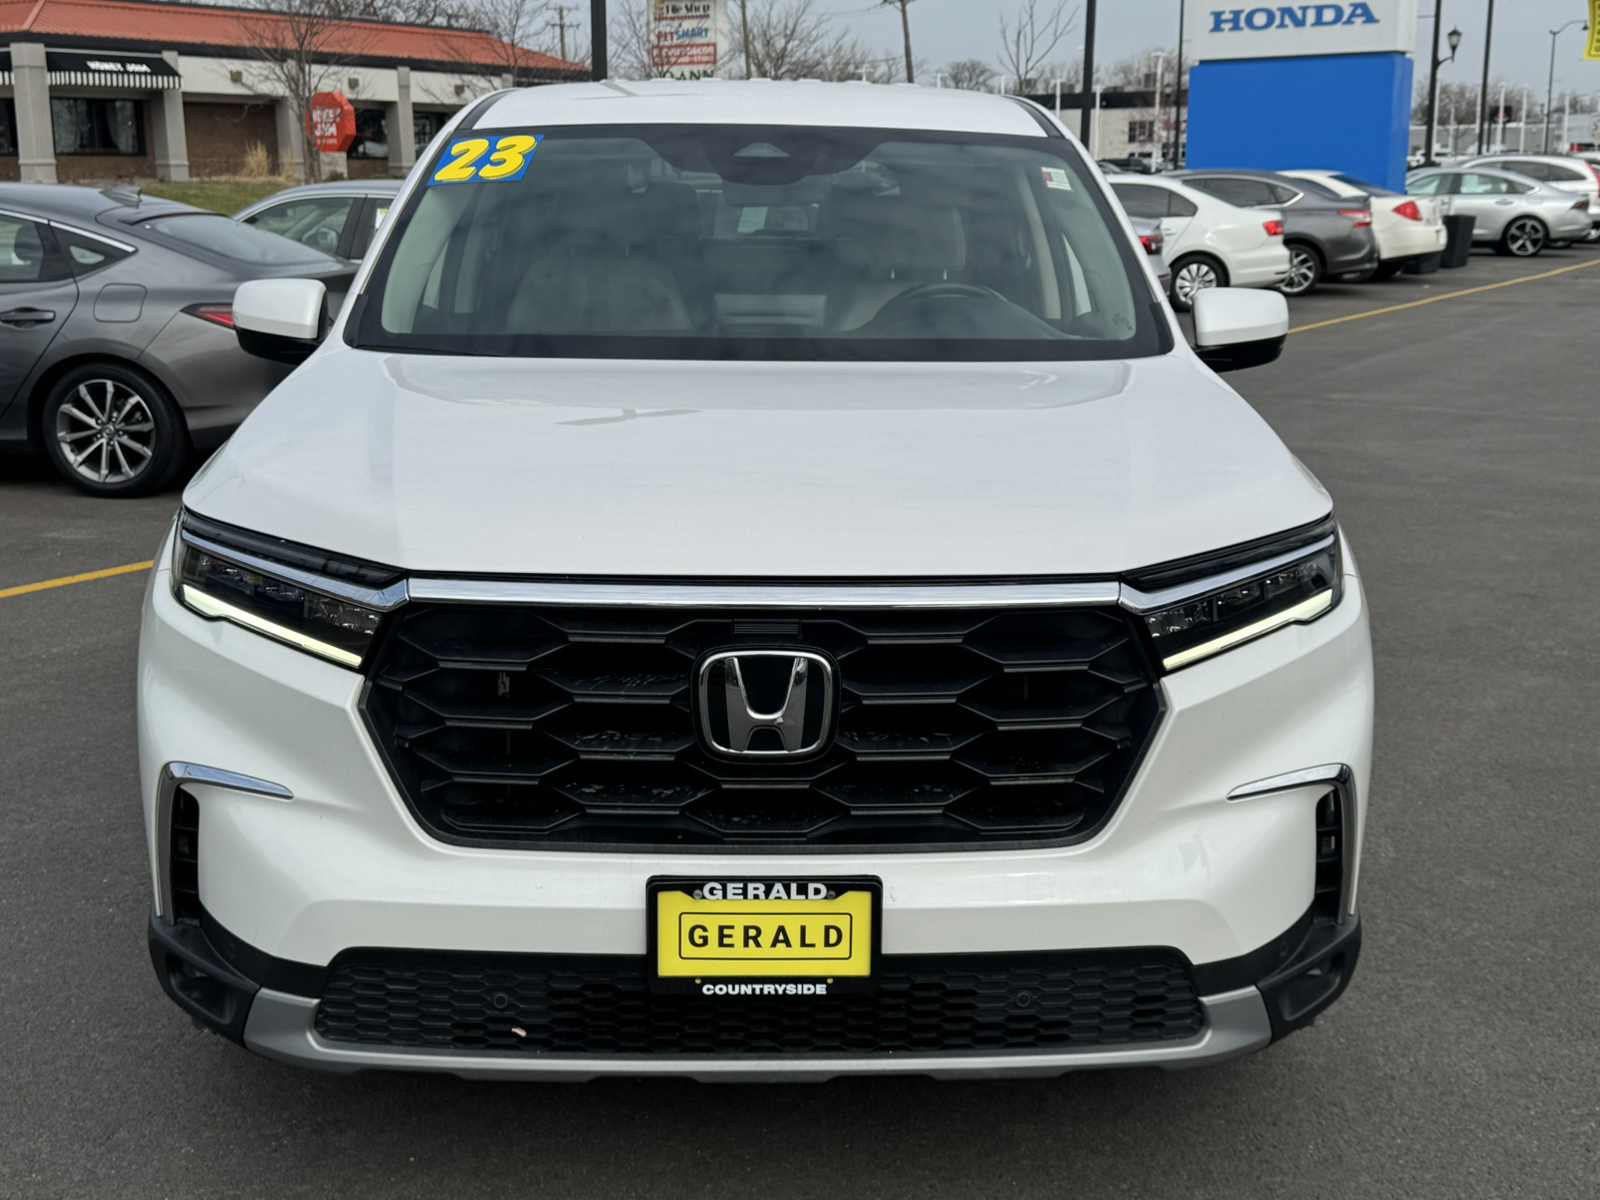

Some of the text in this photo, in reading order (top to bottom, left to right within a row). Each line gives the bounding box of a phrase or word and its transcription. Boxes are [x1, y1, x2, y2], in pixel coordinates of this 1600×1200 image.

[1209, 2, 1380, 33] HONDA
[434, 135, 538, 182] 23
[703, 882, 828, 900] GERALD
[688, 924, 843, 948] GERALD
[702, 983, 827, 995] COUNTRYSIDE
